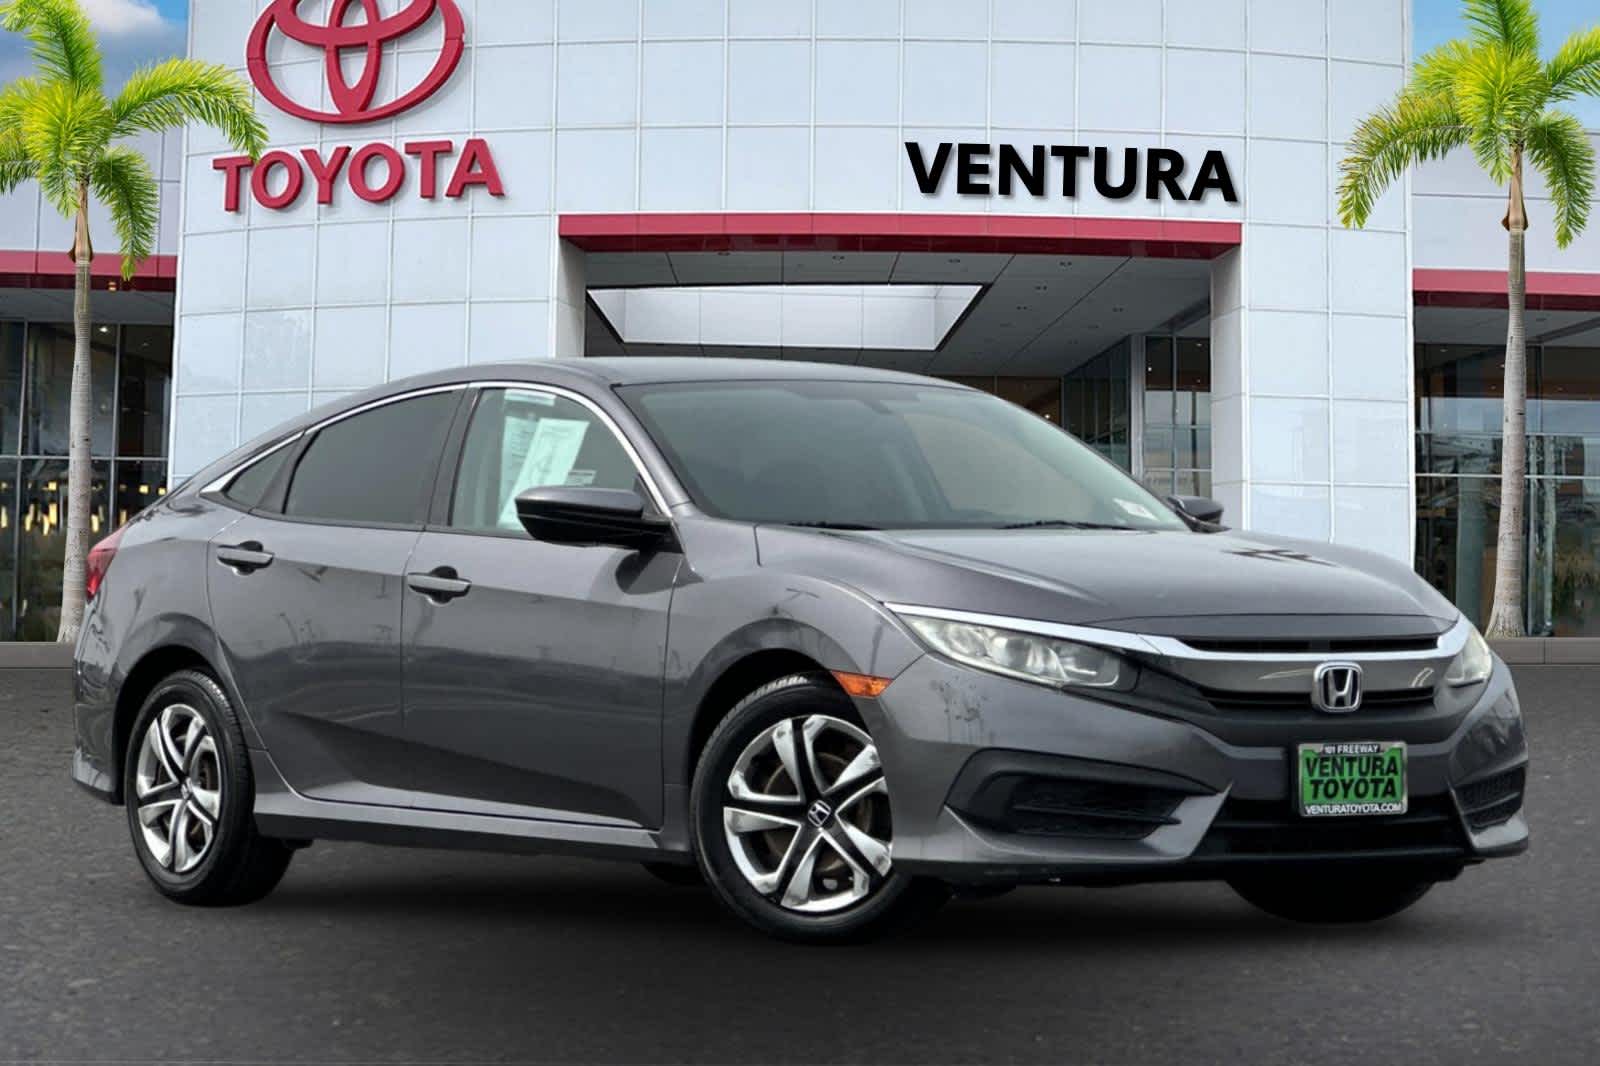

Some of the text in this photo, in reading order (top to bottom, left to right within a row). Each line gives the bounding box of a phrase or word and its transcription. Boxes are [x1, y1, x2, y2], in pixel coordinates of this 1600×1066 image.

[212, 138, 505, 212] TOYOTA
[904, 141, 1238, 203] VENTURA
[1337, 744, 1379, 754] FREEWAY
[1305, 756, 1398, 777] VENTURA
[1310, 778, 1397, 799] TOYOTA
[1305, 803, 1401, 815] VENTURATOYOTA.COM
